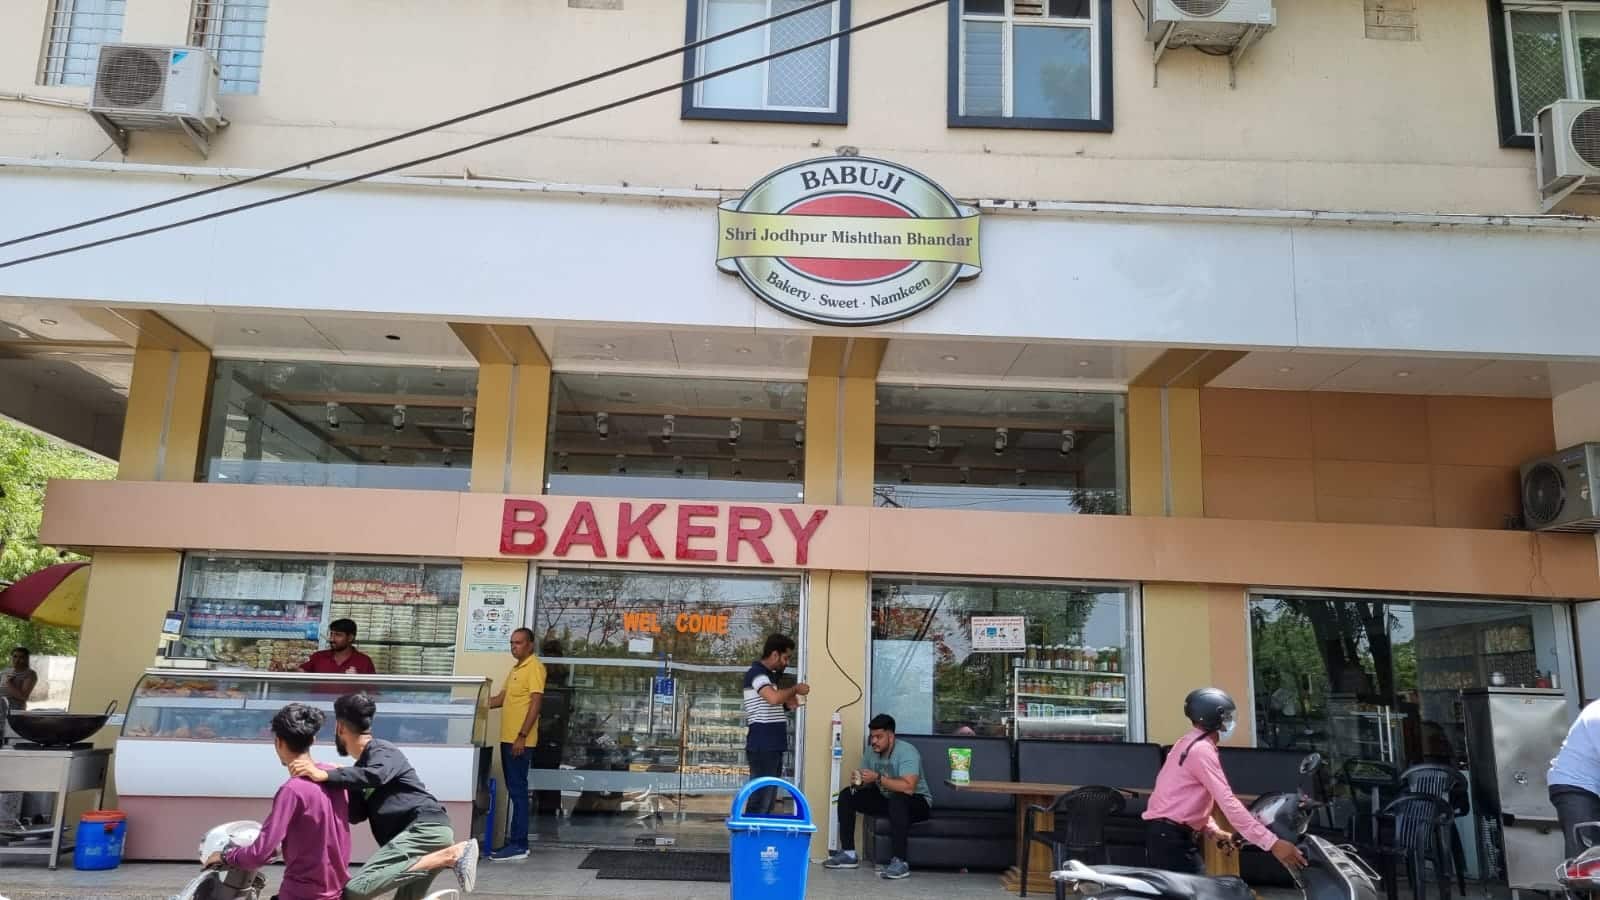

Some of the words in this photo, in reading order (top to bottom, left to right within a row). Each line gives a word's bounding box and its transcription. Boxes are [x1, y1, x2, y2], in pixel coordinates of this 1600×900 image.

[800, 166, 905, 194] BABUJI
[725, 227, 757, 241] Shri
[760, 228, 827, 245] Jodhpur
[832, 231, 902, 245] Mishthan
[906, 232, 973, 247] Bhandar
[766, 271, 811, 302] Bakery
[818, 294, 859, 309] Sweet
[870, 277, 931, 307] Namkeen
[499, 498, 829, 565] BAKERY
[623, 612, 661, 633] WEL
[675, 613, 729, 635] COME
